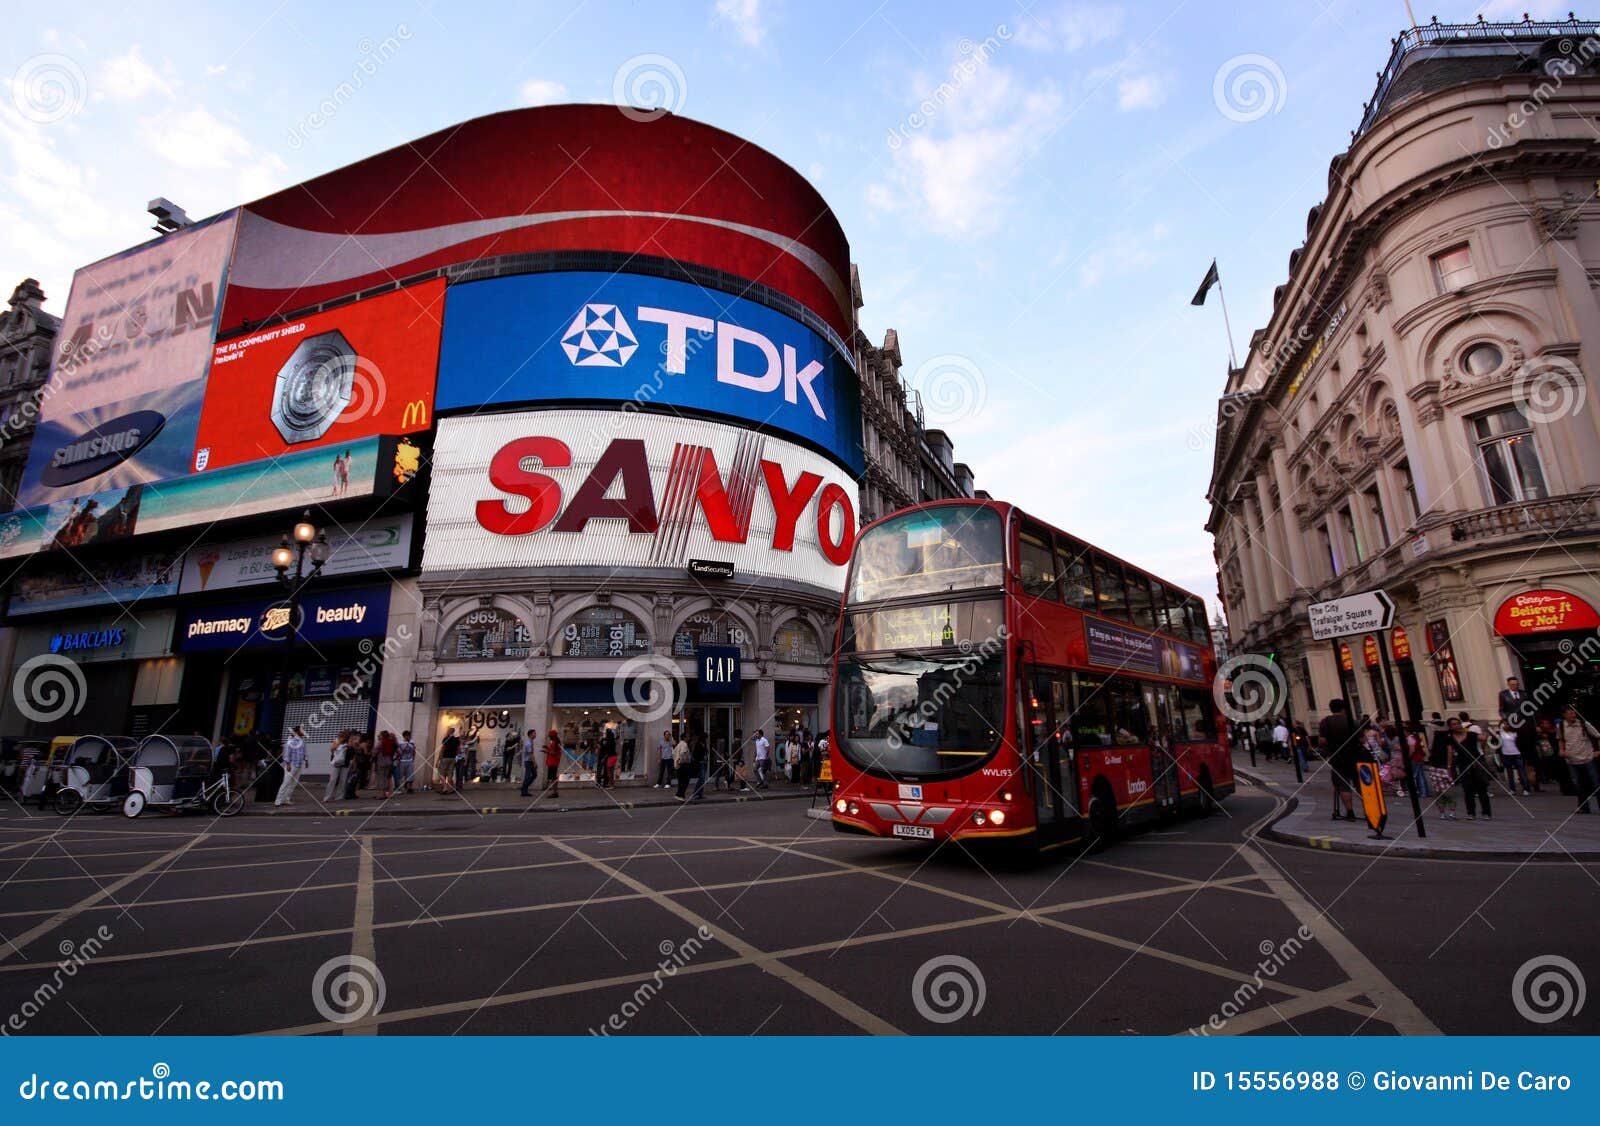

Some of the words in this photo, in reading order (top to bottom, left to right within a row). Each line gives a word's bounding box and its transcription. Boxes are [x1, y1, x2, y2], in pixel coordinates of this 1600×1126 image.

[216, 345, 228, 354] THE
[229, 342, 239, 352] FA
[238, 331, 281, 349] COMMUNITY
[281, 323, 305, 336] SHIELD
[637, 305, 828, 421] TDK
[52, 428, 141, 467] SAMSUNG
[475, 433, 855, 567] SANYO
[188, 617, 252, 638] pharmacy
[316, 603, 367, 623] beauty
[1310, 607, 1323, 615] The
[1324, 604, 1339, 613] City
[1313, 614, 1343, 625] Trafalgar
[1346, 609, 1373, 620] Square
[1510, 604, 1556, 617] Believe
[1559, 601, 1573, 612] It
[1520, 618, 1534, 627] or
[1536, 612, 1565, 626] Not!
[63, 628, 123, 650] BARCLAYS
[1315, 627, 1332, 637] Hyde
[1333, 623, 1350, 633] Park
[1352, 619, 1378, 630] Corner
[706, 656, 735, 683] GAP
